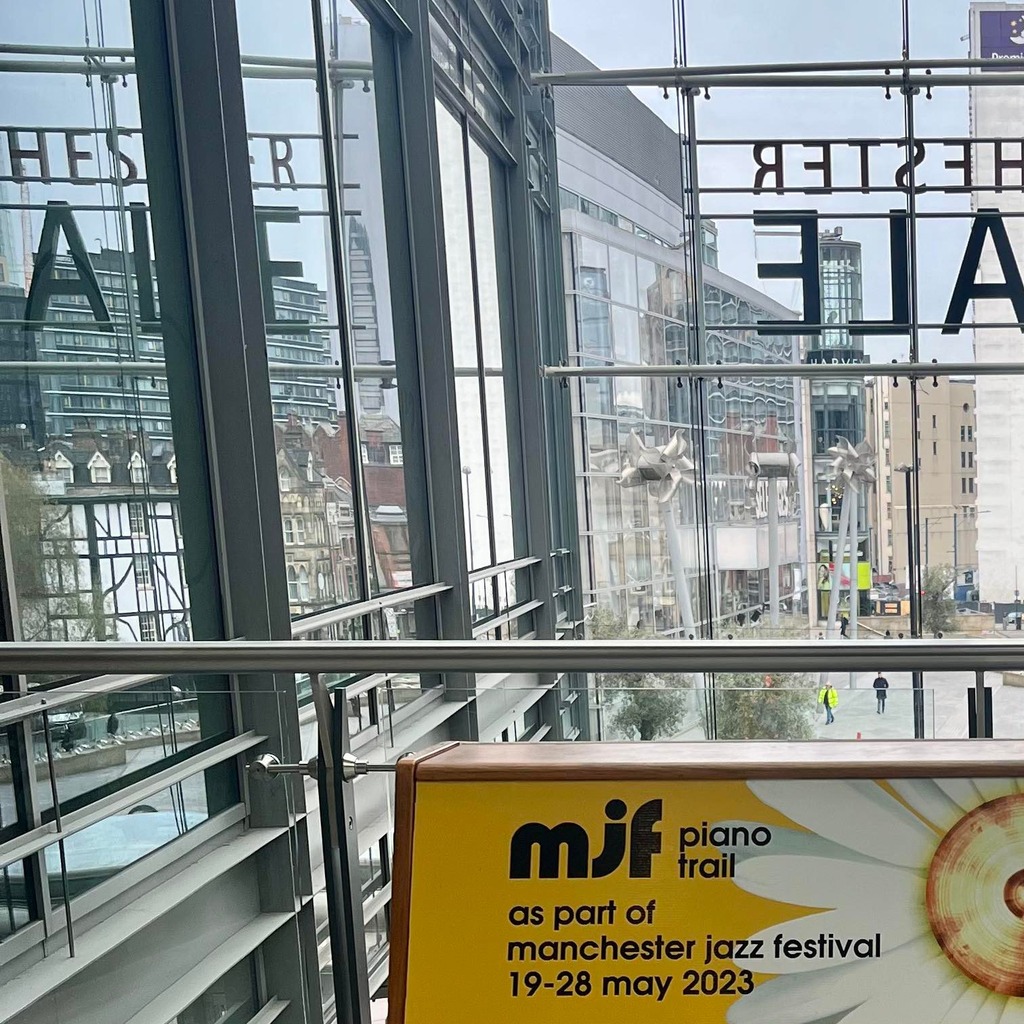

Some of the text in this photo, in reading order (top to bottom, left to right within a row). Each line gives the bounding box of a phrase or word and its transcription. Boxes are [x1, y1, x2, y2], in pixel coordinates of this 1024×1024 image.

[509, 798, 663, 879] mjf
[679, 822, 772, 853] piano
[678, 852, 735, 879] trail
[508, 899, 656, 931] as part of
[507, 933, 881, 965] manchester jazz festival
[510, 969, 755, 1001] 19-28 may 2023
